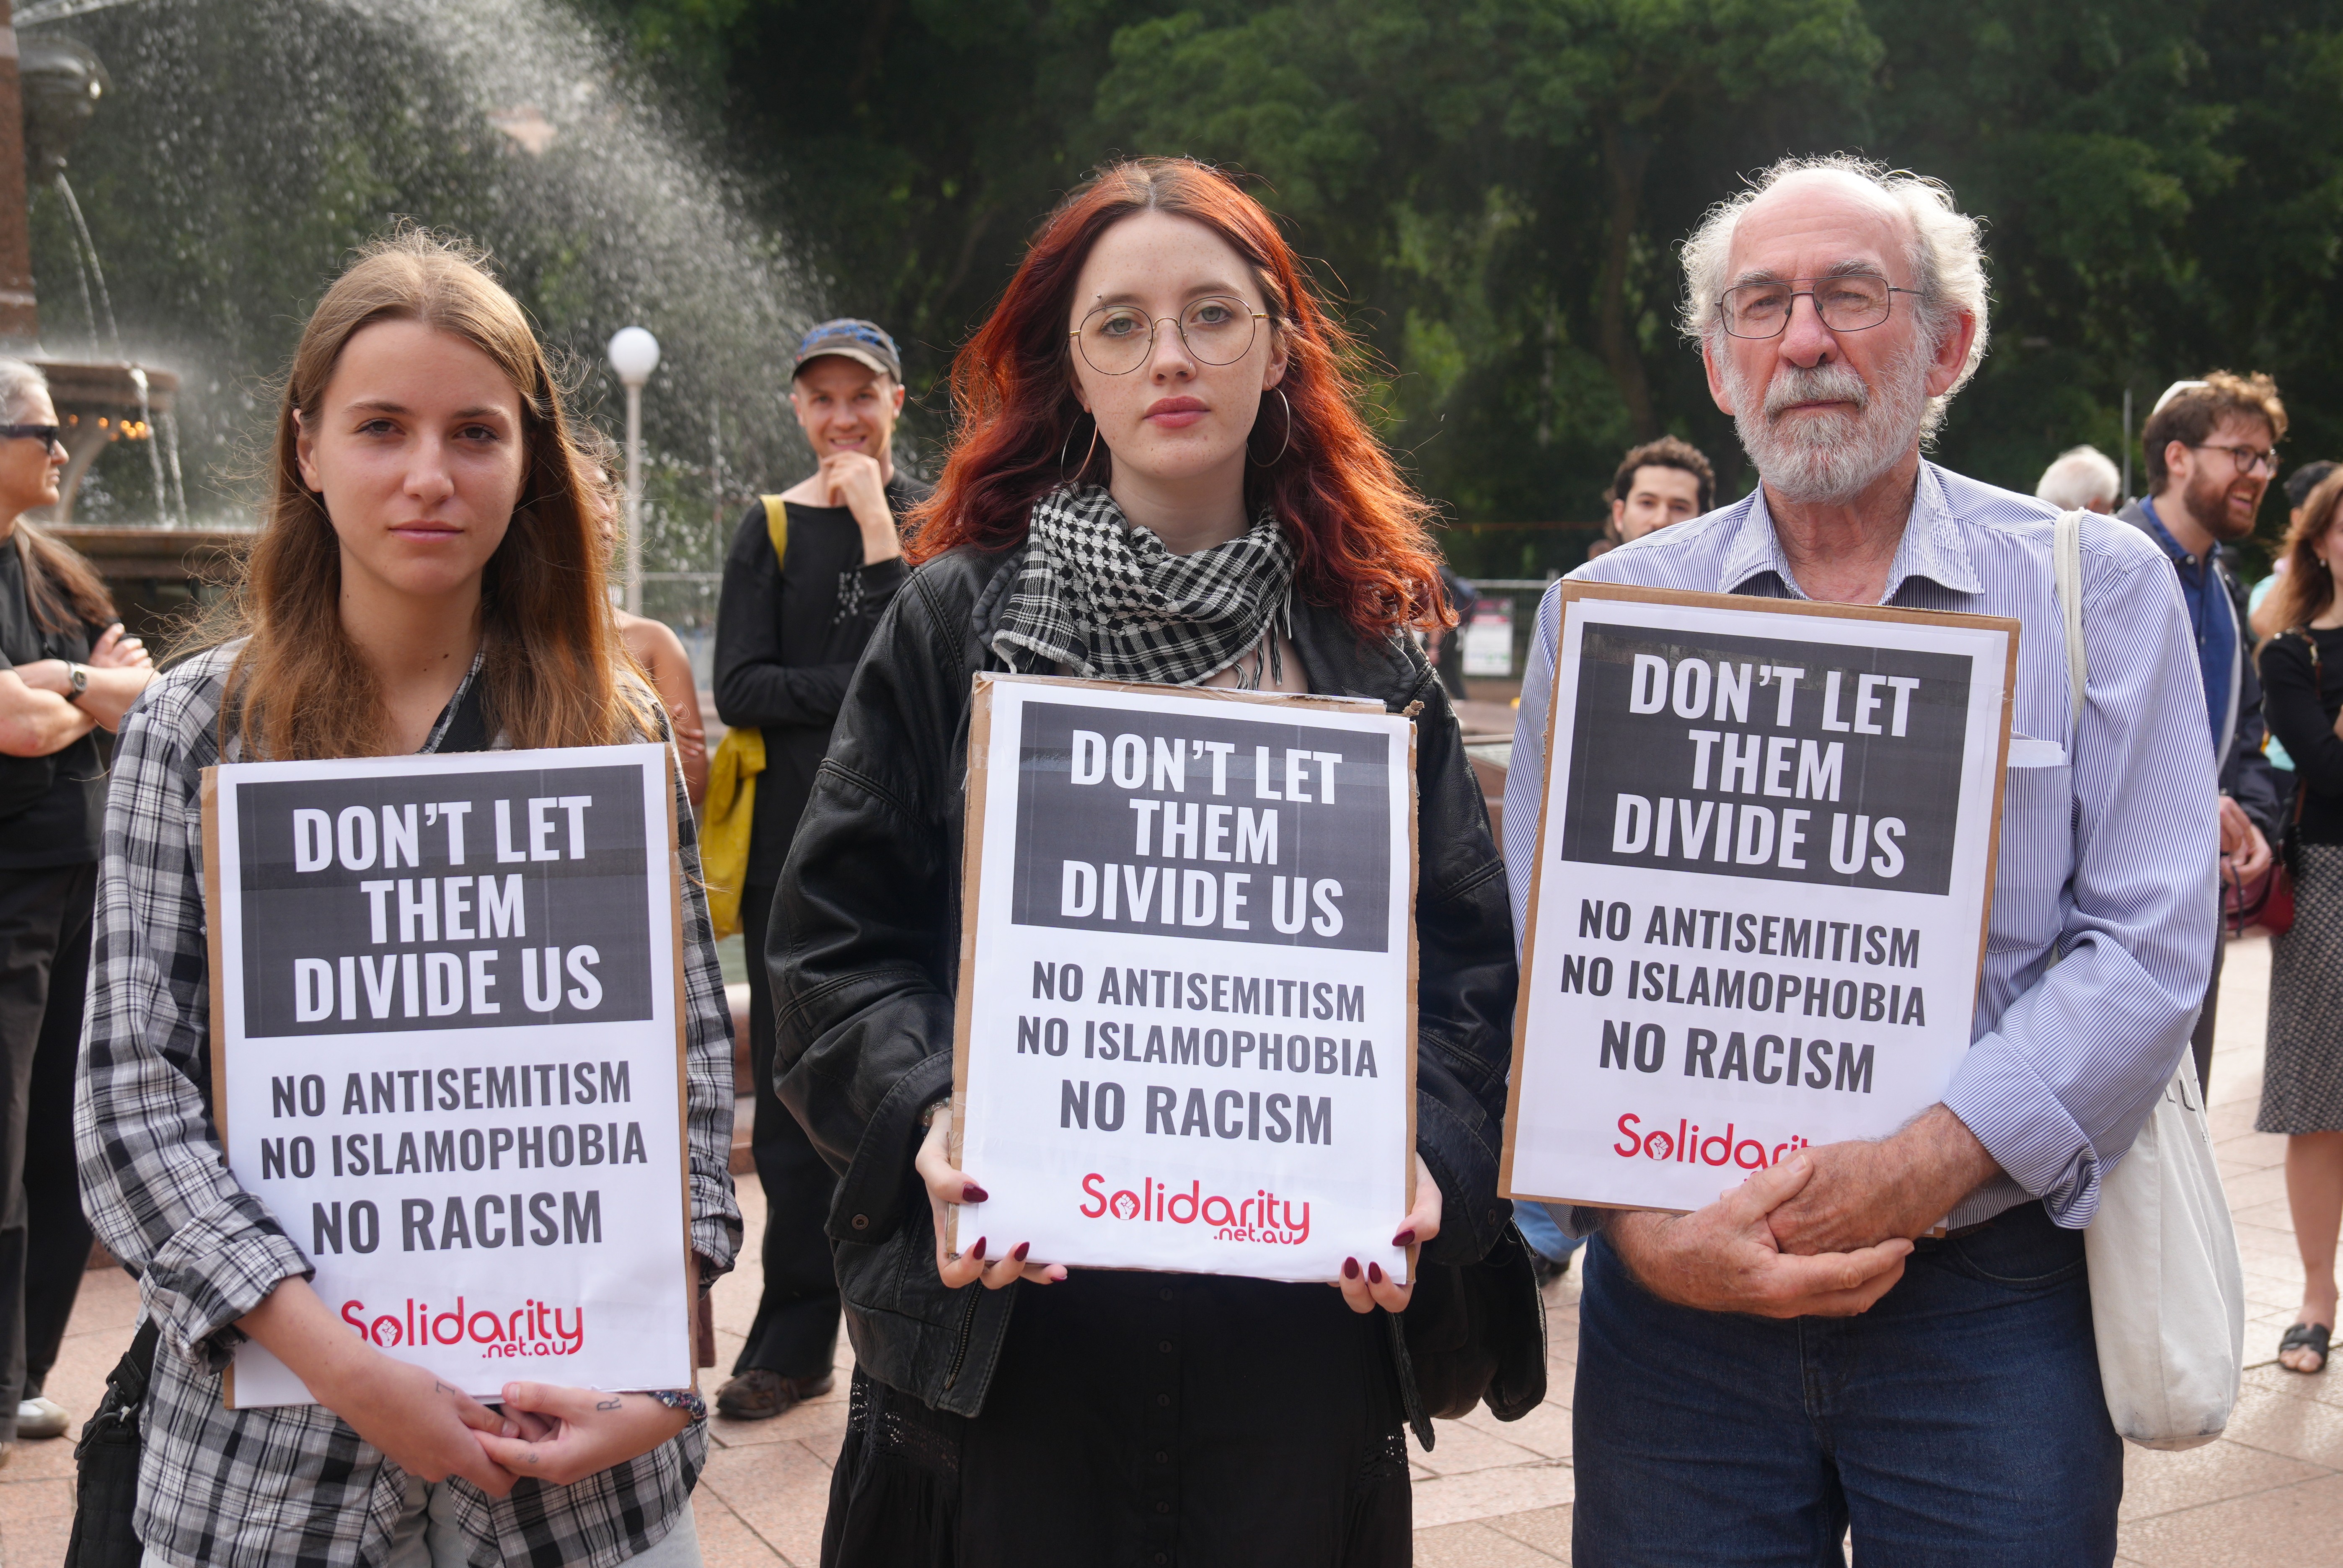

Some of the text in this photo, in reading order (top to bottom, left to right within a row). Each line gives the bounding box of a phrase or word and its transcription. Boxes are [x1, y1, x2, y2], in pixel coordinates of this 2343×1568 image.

[1630, 654, 1919, 737] DON'T LET
[1071, 730, 1342, 805] DON'T LET
[1689, 730, 1844, 802] THEM
[294, 796, 592, 872] DON'T LET
[1130, 799, 1278, 865] THEM
[1613, 794, 1906, 877] DIVIDE US
[361, 874, 525, 943] THEM
[1061, 860, 1343, 937] DIVIDE US
[1579, 899, 1919, 968] NO ANTISEMITISM
[295, 945, 603, 1022] DIVIDE US
[1033, 961, 1364, 1022] NO ANTISEMITISM
[1561, 955, 1924, 1026] NO ISLAMOPHOBIA
[1018, 1016, 1377, 1077] NO ISLAMOPHOBIA
[1600, 1020, 1874, 1093] NO RACISM
[272, 1061, 630, 1118] NO ANTISEMITISM
[1061, 1080, 1331, 1145] NO RACISM
[261, 1122, 647, 1180] NO ISLAMOPHOBIA
[313, 1191, 601, 1255] NO RACISM
[1080, 1174, 1309, 1245] Solidarity
[341, 1296, 583, 1355] Solidarity
